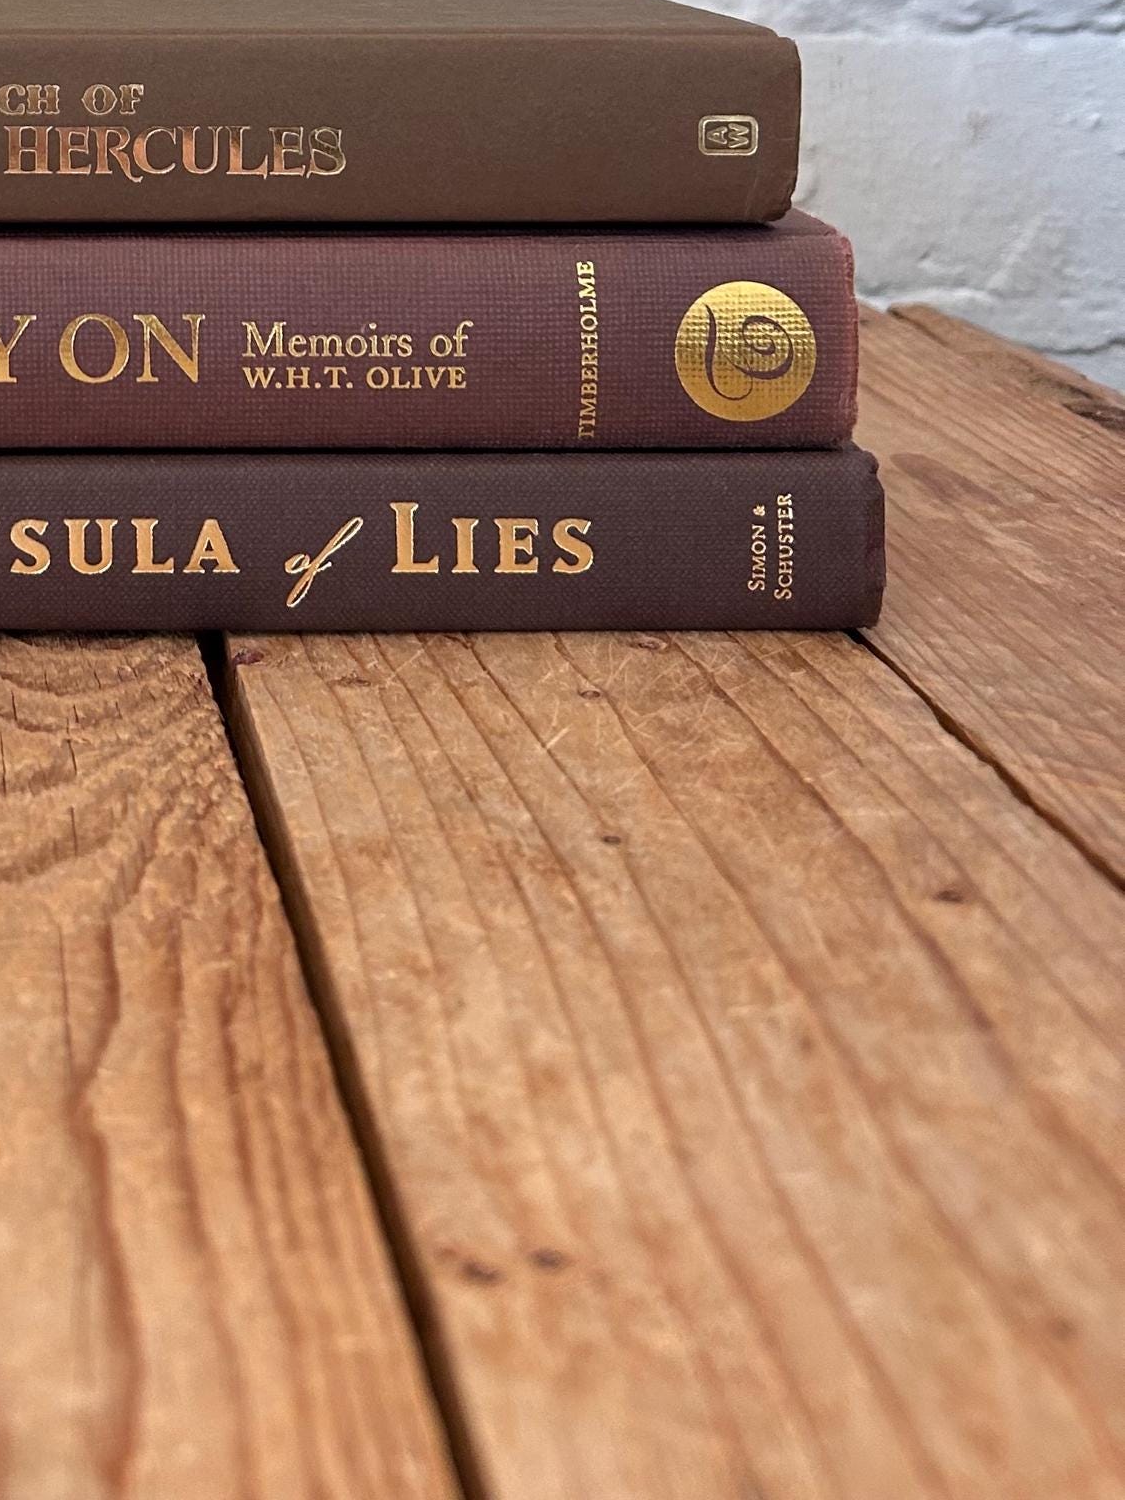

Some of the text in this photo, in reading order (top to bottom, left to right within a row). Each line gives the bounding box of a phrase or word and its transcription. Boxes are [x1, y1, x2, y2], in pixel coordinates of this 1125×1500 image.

[81, 83, 145, 116] OF
[3, 124, 347, 183] HERCULES
[58, 313, 206, 384] ON
[242, 318, 474, 359] Memoirs of
[576, 260, 599, 440] TIMBERHOLME
[242, 364, 468, 390] W.H.T. OLIVE
[284, 516, 364, 608] of
